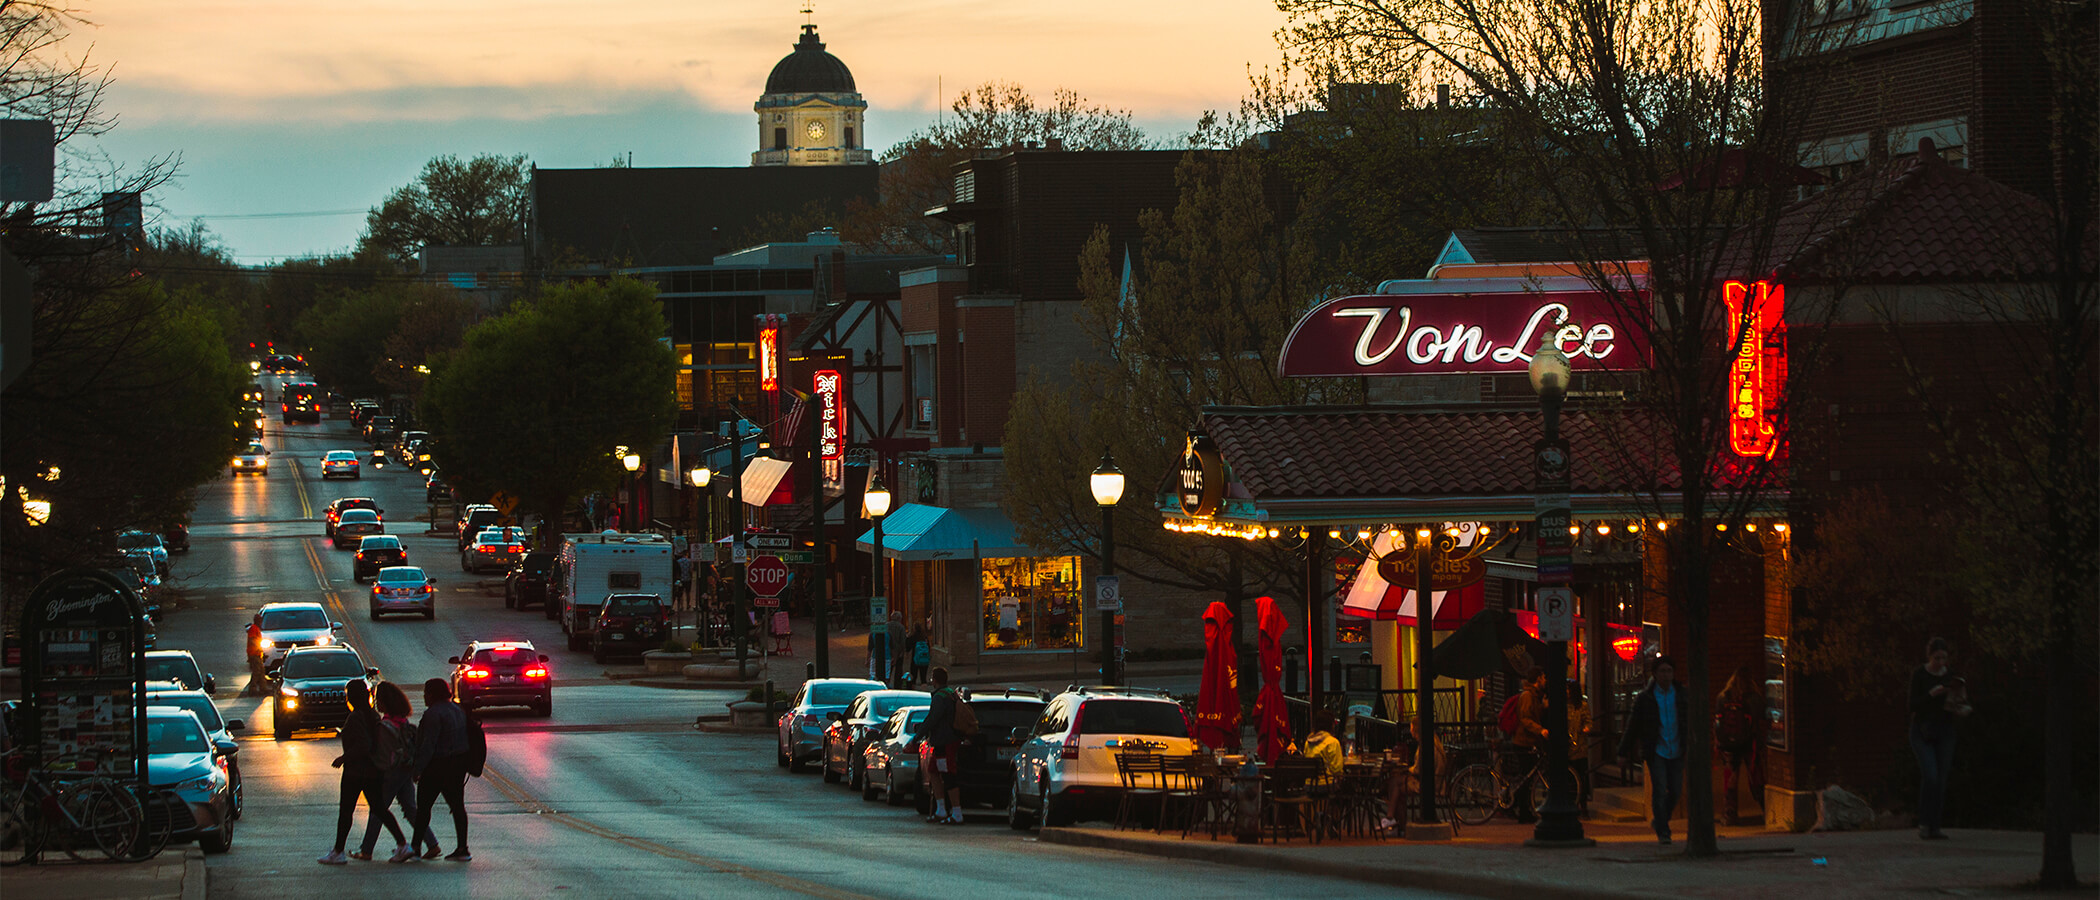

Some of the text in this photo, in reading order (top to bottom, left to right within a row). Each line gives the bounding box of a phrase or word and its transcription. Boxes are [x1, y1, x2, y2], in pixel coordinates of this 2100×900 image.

[1333, 302, 1616, 365] Von Lee
[816, 375, 838, 456] Nick's
[1541, 517, 1567, 527] BUS
[1539, 528, 1569, 538] STOP
[758, 538, 788, 546] ONE WAY
[784, 553, 803, 561] Dunn
[1394, 553, 1471, 573] nodles
[750, 568, 786, 584] STOP
[1431, 575, 1463, 583] mpany
[46, 592, 114, 621] Bloomington
